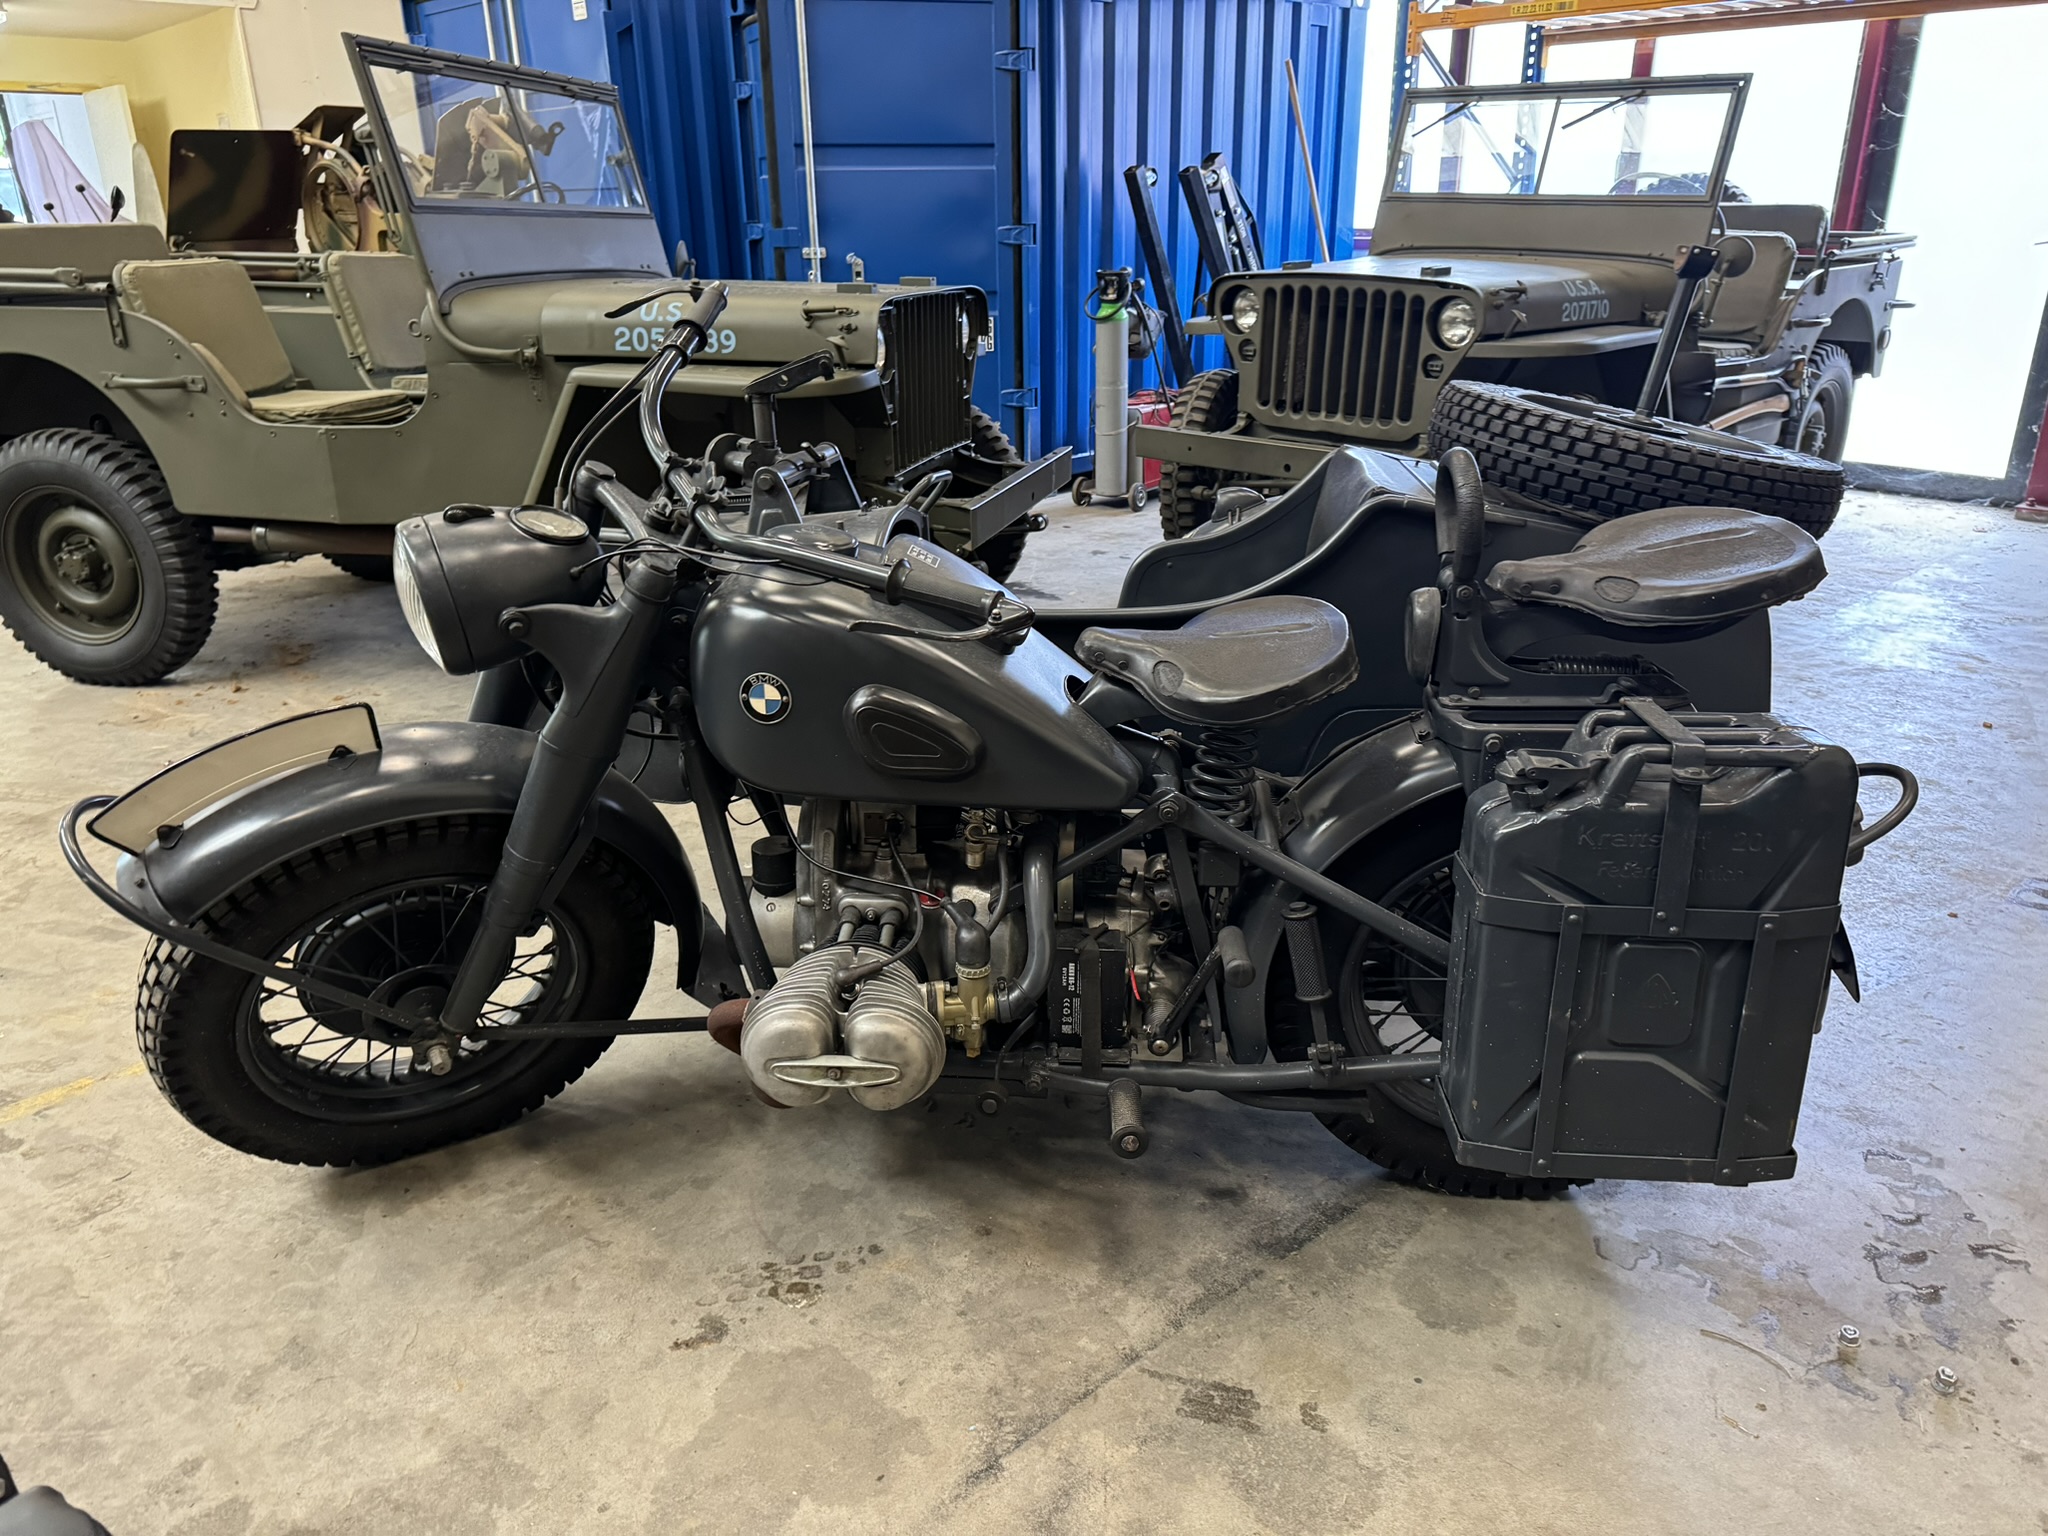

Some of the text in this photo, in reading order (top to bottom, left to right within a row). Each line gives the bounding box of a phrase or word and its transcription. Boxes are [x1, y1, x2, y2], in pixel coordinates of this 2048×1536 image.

[1562, 279, 1606, 297] U.S.A.
[1562, 299, 1610, 322] 2071710
[749, 675, 781, 687] BMW
